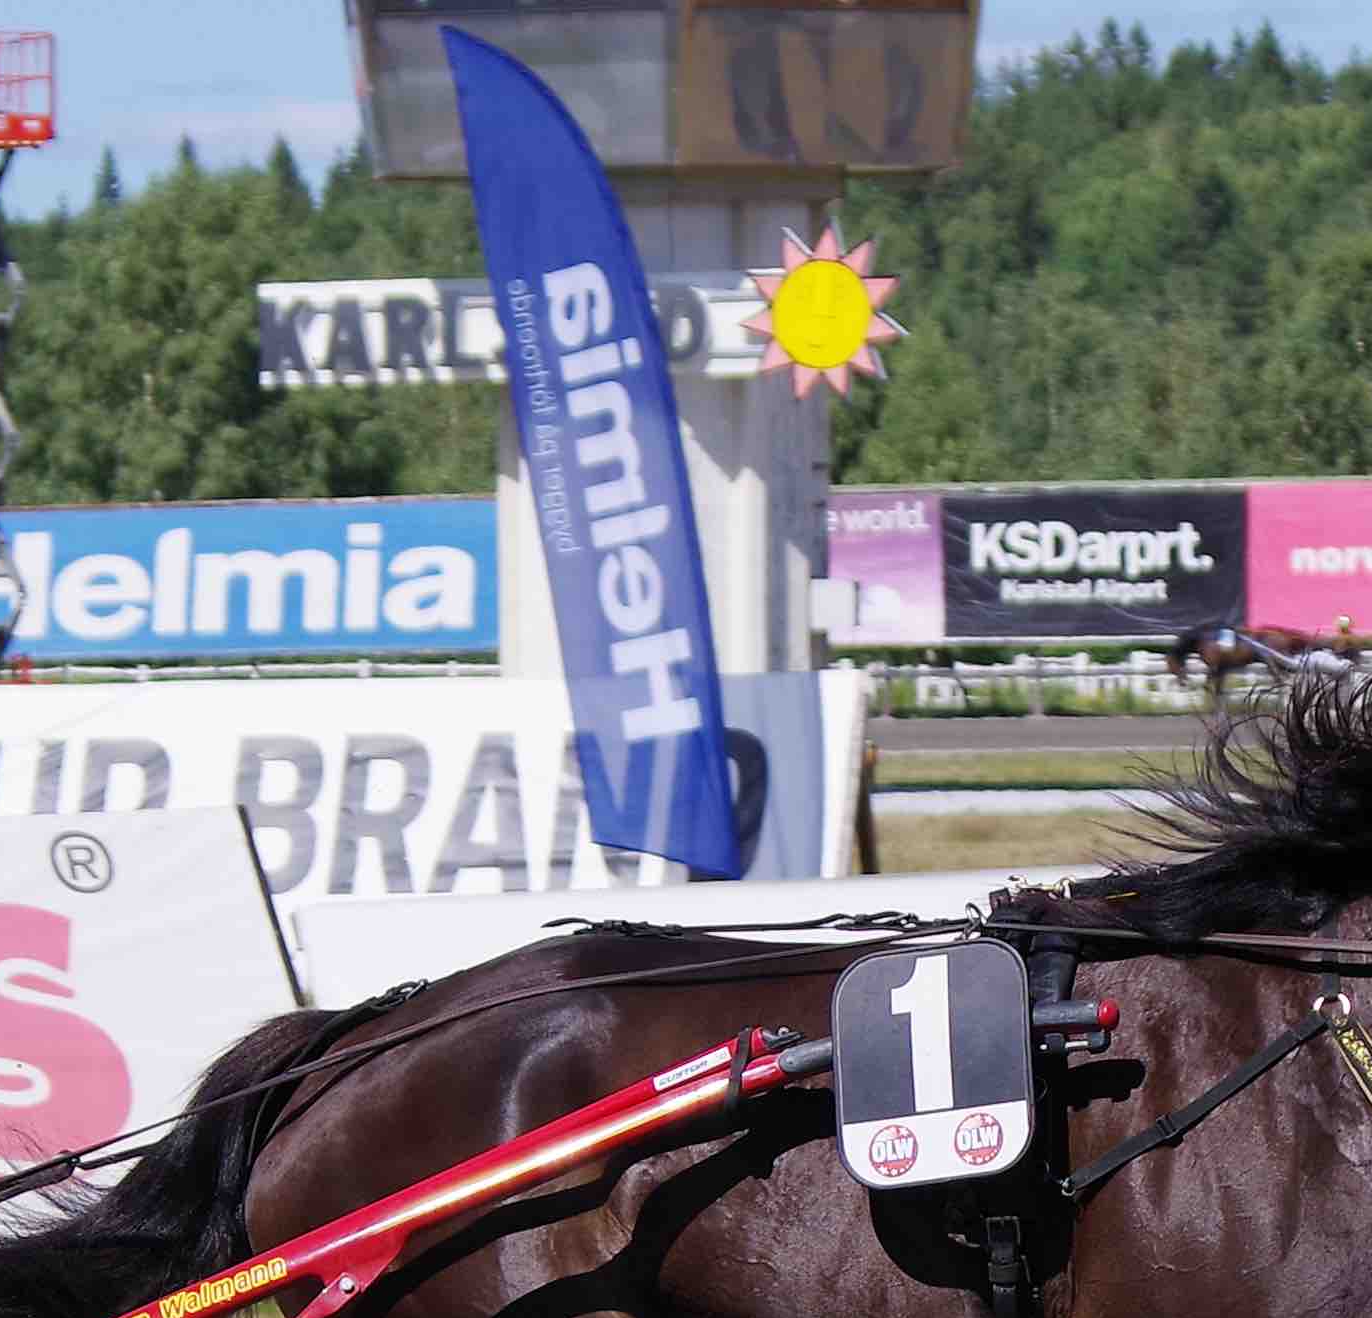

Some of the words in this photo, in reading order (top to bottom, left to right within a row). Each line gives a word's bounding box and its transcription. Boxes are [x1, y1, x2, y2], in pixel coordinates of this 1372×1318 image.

[891, 953, 954, 1113] 1
[871, 1137, 914, 1164] OLW
[957, 1125, 999, 1152] OLW
